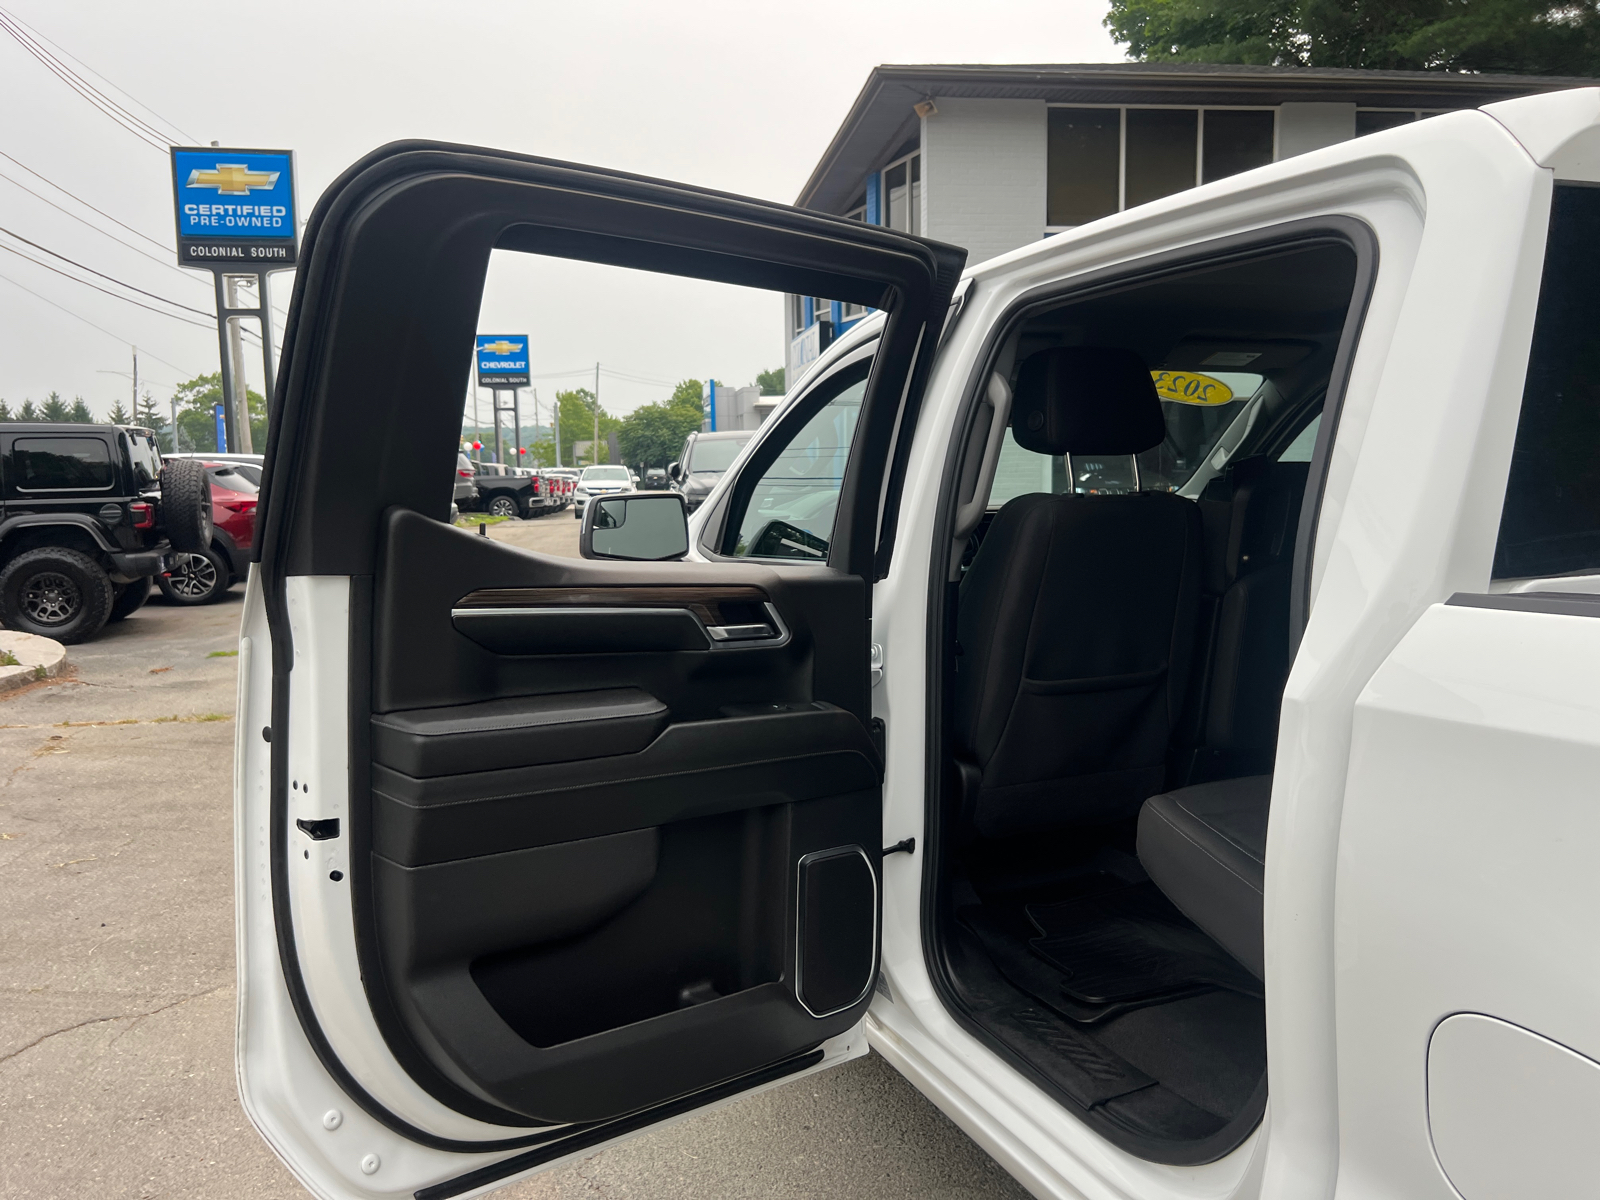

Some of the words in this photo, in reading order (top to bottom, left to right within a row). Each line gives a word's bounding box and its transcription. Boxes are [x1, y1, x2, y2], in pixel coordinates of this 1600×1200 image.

[184, 204, 286, 216] CERTIFIED
[190, 216, 282, 227] PRE-OWNED
[190, 246, 245, 257] COLONIAL
[251, 247, 286, 258] SOUTH
[481, 361, 526, 369] CHEVROLET
